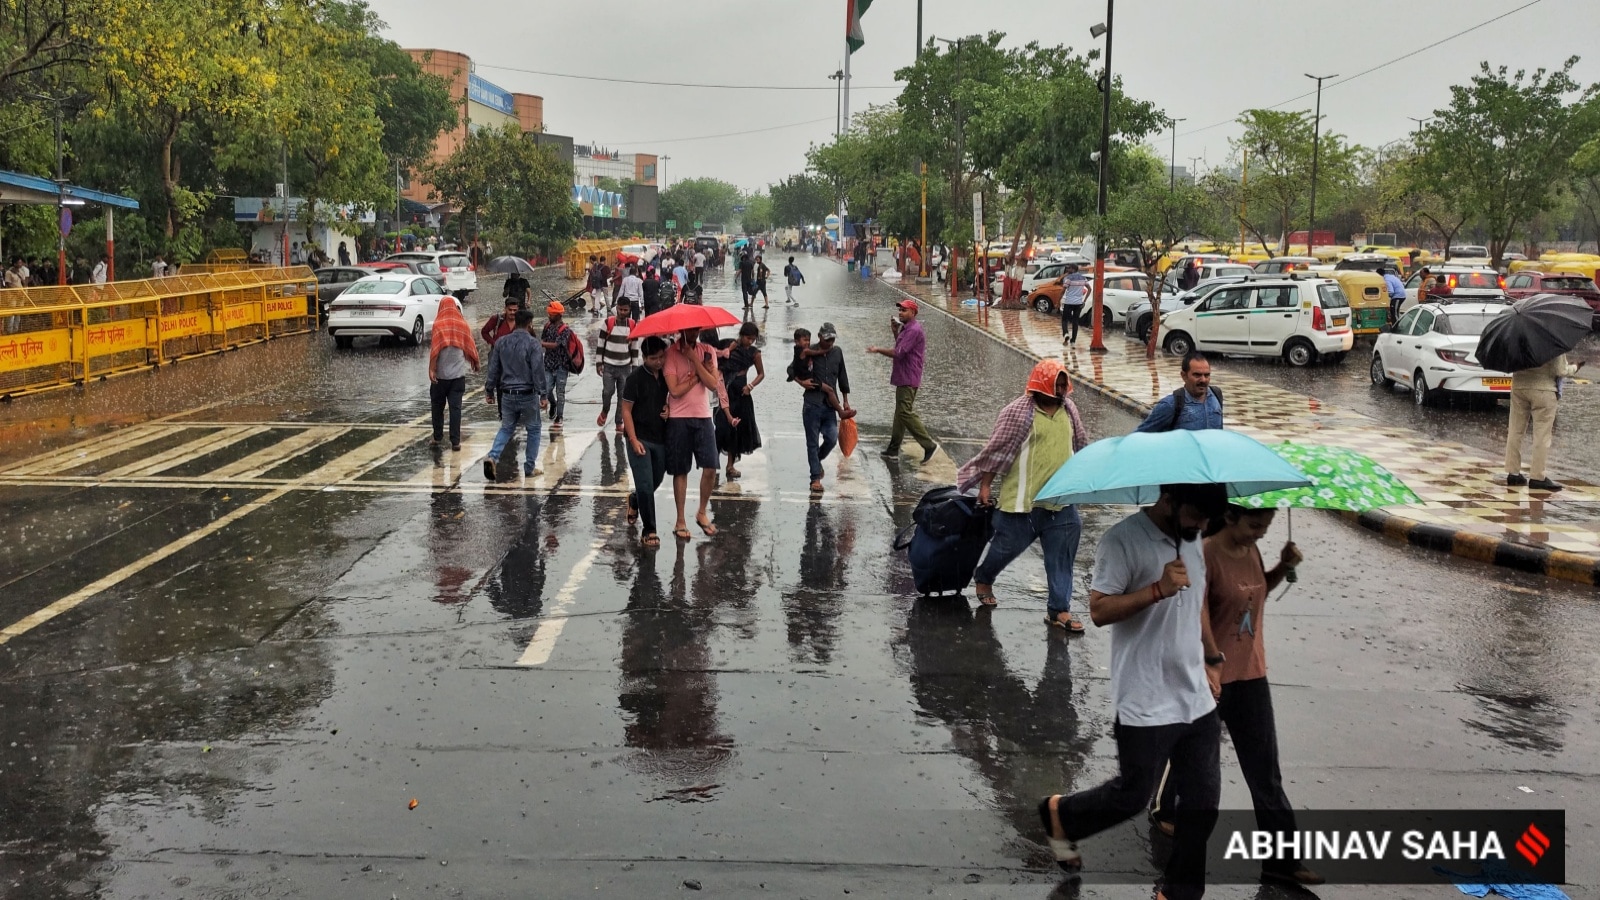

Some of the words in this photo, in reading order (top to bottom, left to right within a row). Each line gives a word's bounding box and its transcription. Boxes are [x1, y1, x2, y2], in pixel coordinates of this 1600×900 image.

[266, 302, 276, 312] ELHI
[278, 301, 292, 311] POLICE
[179, 316, 197, 329] POLICE
[88, 327, 106, 345] दिल्ली
[107, 326, 125, 345] पुलिस
[0, 339, 18, 361] ल्ली
[20, 337, 44, 360] पुलिस
